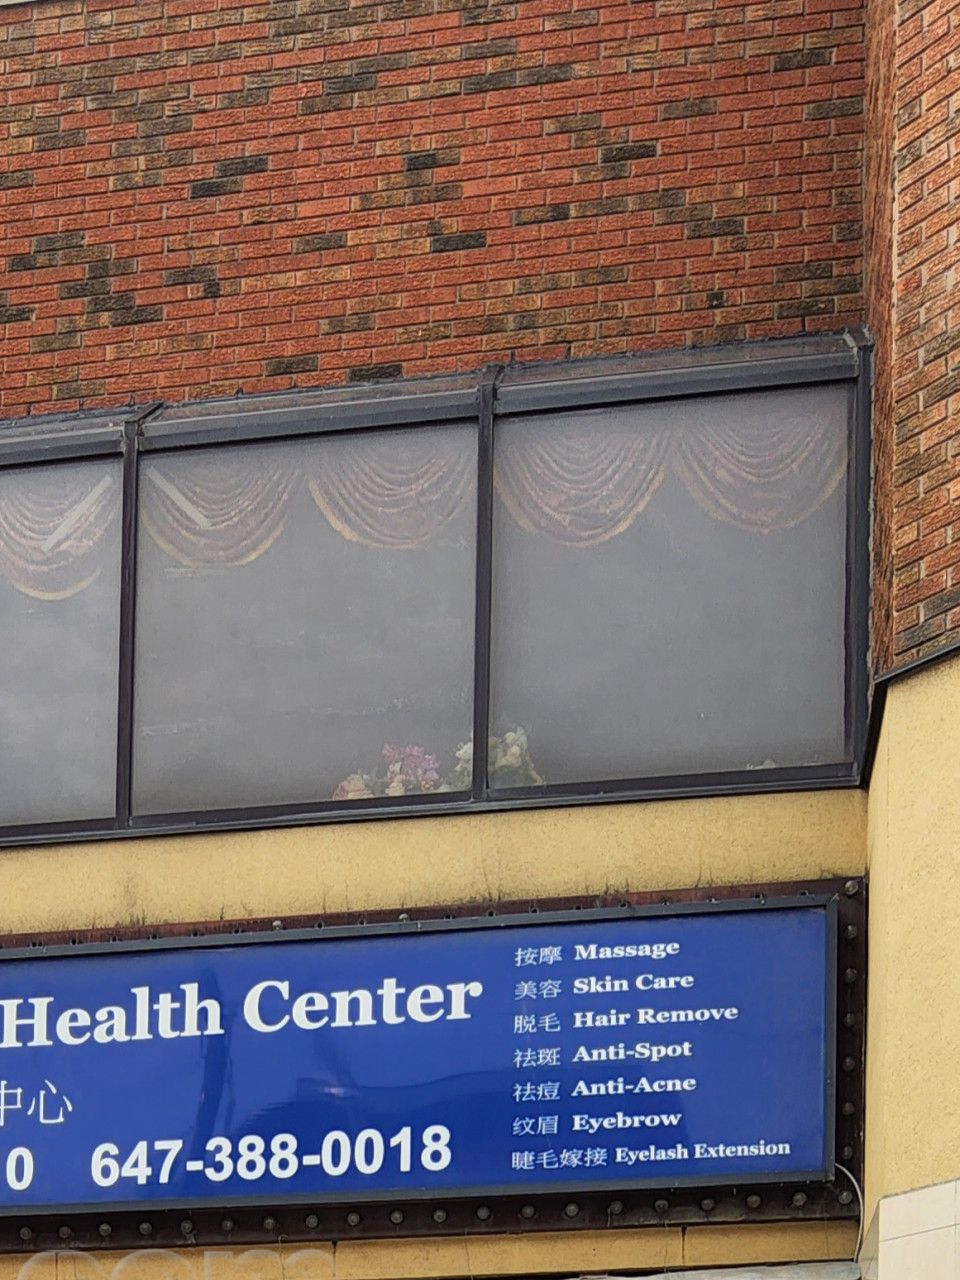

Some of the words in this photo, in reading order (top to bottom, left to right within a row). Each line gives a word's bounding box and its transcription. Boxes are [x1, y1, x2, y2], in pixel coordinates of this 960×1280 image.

[514, 946, 562, 967] 按摩
[574, 941, 680, 960] Massage
[514, 980, 562, 1000] 美容
[573, 976, 629, 994] Skin
[635, 973, 694, 990] Care
[243, 978, 483, 1033] Center
[513, 1014, 561, 1034] 脱毛
[573, 1009, 631, 1029] Hair
[637, 1006, 739, 1025] Remove
[513, 1047, 561, 1069] 祛斑
[572, 1041, 692, 1063] Anti-Spot
[513, 1081, 561, 1102] 祛痘
[571, 1076, 697, 1097] Anti-Acne
[512, 1115, 559, 1136] 纹眉
[572, 1111, 682, 1133] Eyebrow
[91, 1124, 452, 1187] 647-388-0018
[615, 1143, 689, 1165] Eyelash
[694, 1139, 791, 1158] Extension
